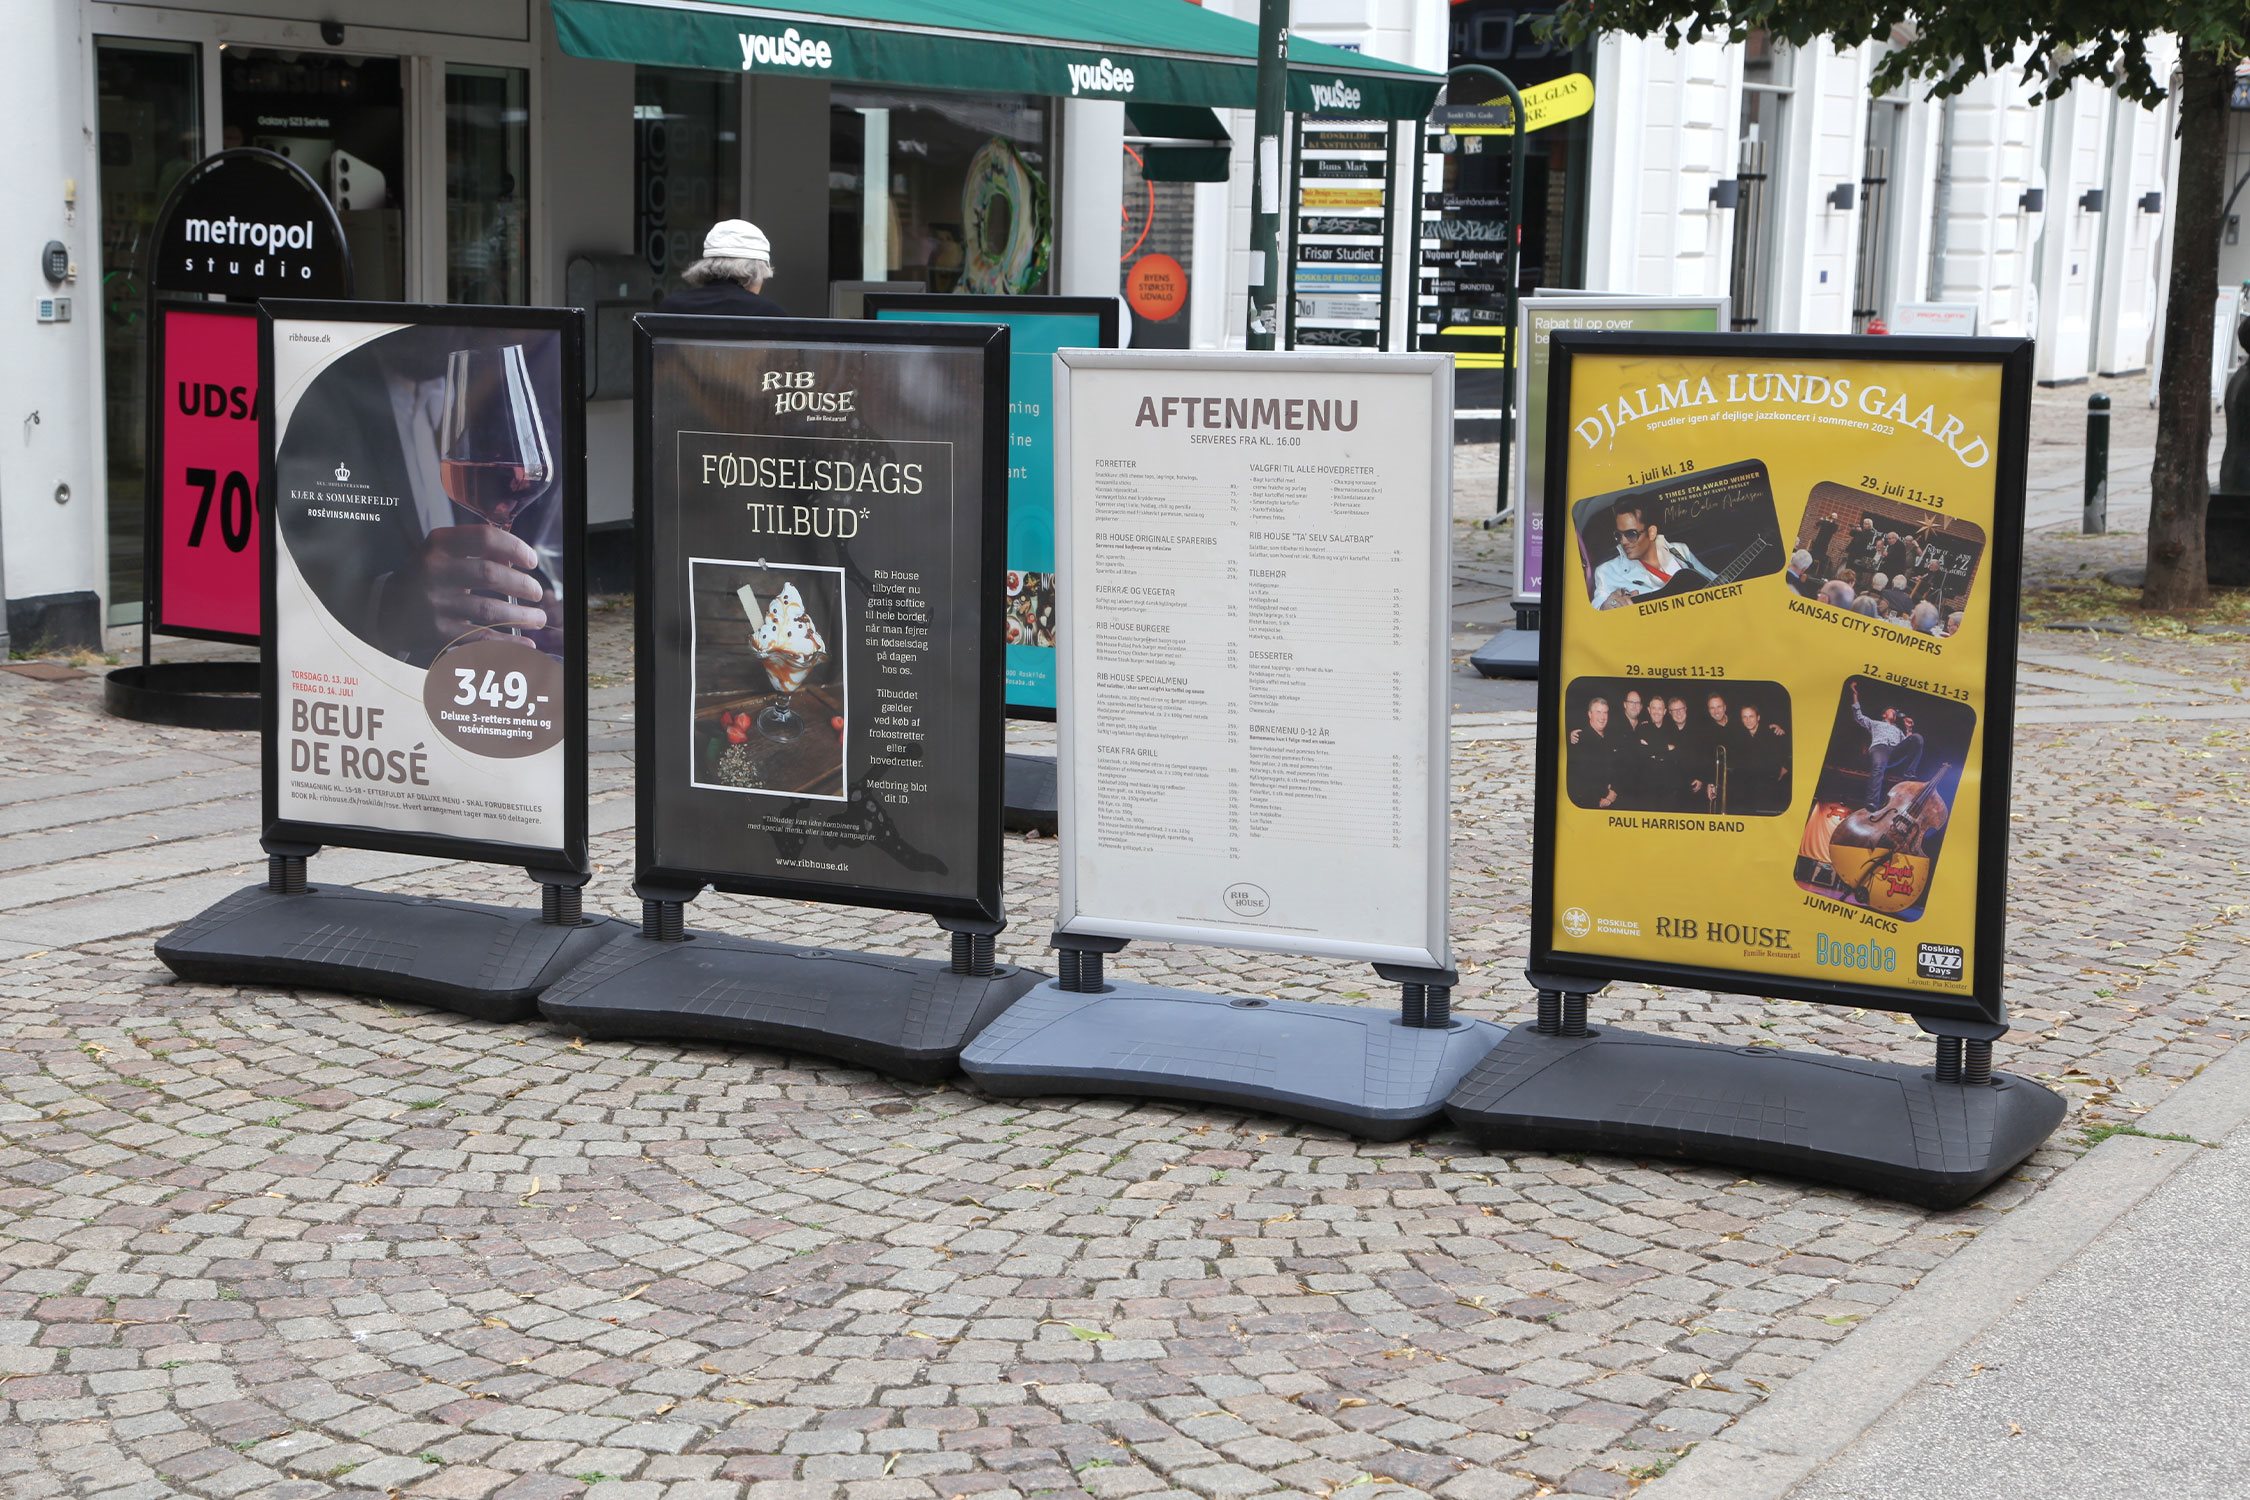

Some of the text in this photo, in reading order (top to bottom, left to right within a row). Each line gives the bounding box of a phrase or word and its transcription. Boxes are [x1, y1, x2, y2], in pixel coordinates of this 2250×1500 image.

[738, 27, 832, 71] youSee
[1068, 57, 1134, 95] youSee
[1310, 79, 1361, 111] youSee
[1544, 81, 1578, 101] GLAS
[1447, 111, 1464, 119] Sankt
[1478, 111, 1494, 119] Gade
[258, 116, 329, 128] Galaxy S23 Series
[1319, 161, 1368, 171] Buus Mark
[185, 214, 313, 256] metropol
[1305, 247, 1374, 260] Frisør Studiet
[1426, 251, 1459, 262] Nygaard
[185, 257, 312, 279] studio
[1296, 274, 1332, 282] ROSKILDE
[1535, 318, 1633, 330] Rabat til op over
[288, 333, 331, 344] ribhouse.dk
[761, 370, 815, 392] RIB
[774, 390, 856, 415] HOUSE
[1135, 396, 1358, 432] AFTENMENU
[1575, 373, 1990, 471] DJALMA LUNDS GAARD
[1646, 415, 1685, 432] sprudler
[1688, 413, 1708, 425] igen
[1710, 411, 1721, 422] af
[1722, 410, 1754, 424] dejlige
[1755, 410, 1810, 423] jazzkoncert
[1818, 416, 1869, 431] sommeren
[1872, 422, 1895, 436] 2023
[1190, 434, 1301, 447] SERVERES FRA KL. 16.00
[1095, 460, 1137, 468] FORRETTER
[1250, 464, 1374, 475] VALGFRI TIL ALLE HOVEDRETTER
[702, 452, 923, 495] FØDSELSDAGS
[1628, 460, 1694, 485] 1. juli kl. 18
[291, 490, 399, 506] KJÆR & SOMMERFELDT
[1861, 475, 1944, 509] 29. juli 11-13
[186, 467, 260, 553] 70
[1096, 533, 1217, 545] RIB HOUSE ORIGINALE SPARERIBS
[874, 569, 919, 581] Rib House
[1249, 569, 1287, 578] TILBEHØR
[872, 583, 921, 595] tilbyder nu
[1096, 585, 1175, 596] FJERKRÆ OG VEGETAR
[868, 597, 925, 608] gratis softice
[1638, 584, 1743, 617] ELVIS IN CONCERT
[865, 611, 875, 620] til
[876, 611, 895, 620] hele
[865, 624, 928, 636] når man fejrer
[1789, 599, 1943, 656] KANSAS CITY STOMPERS
[865, 638, 928, 650] sin fødselsdag
[877, 652, 917, 664] på dagen
[1249, 651, 1293, 660] DESSERTER
[882, 665, 913, 675] hos os.
[1626, 664, 1724, 678] 29. august 11-13
[291, 670, 359, 686] TORSDAG D. 13. JULI
[1863, 663, 1970, 702] 12. august 11-13
[453, 667, 549, 717] 349,-
[877, 688, 918, 700] Tilbuddet
[881, 703, 913, 714] gælder
[291, 698, 384, 741] BŒUF
[441, 710, 552, 730] Deluxe 3-retters menu og
[874, 716, 920, 727] ved køb af
[458, 723, 533, 739] rosévinsmagning
[869, 728, 925, 741] frokostretter
[1250, 724, 1330, 737] BØRNEMENU 0-12 ÅR
[886, 743, 906, 753] eller
[1098, 746, 1120, 754] STEAK
[1137, 749, 1158, 757] GRILL
[291, 739, 430, 786] DE ROSÉ
[870, 755, 924, 768] hovedretter.
[1608, 816, 1744, 833] PAUL HARRISON BAND
[776, 857, 849, 871] www.ribhouse.dk
[1236, 899, 1264, 907] HOUSE
[1597, 917, 1640, 929] ROSKILDE
[1859, 910, 1898, 934] JACKS
[1597, 926, 1641, 937] KOMMUNE
[1655, 916, 1792, 950] RIB HOUSE
[1817, 932, 1897, 973] Bosaba
[1920, 942, 1961, 955] Roskilde
[1919, 955, 1962, 968] JAZZ
[1928, 966, 1951, 975] Days
